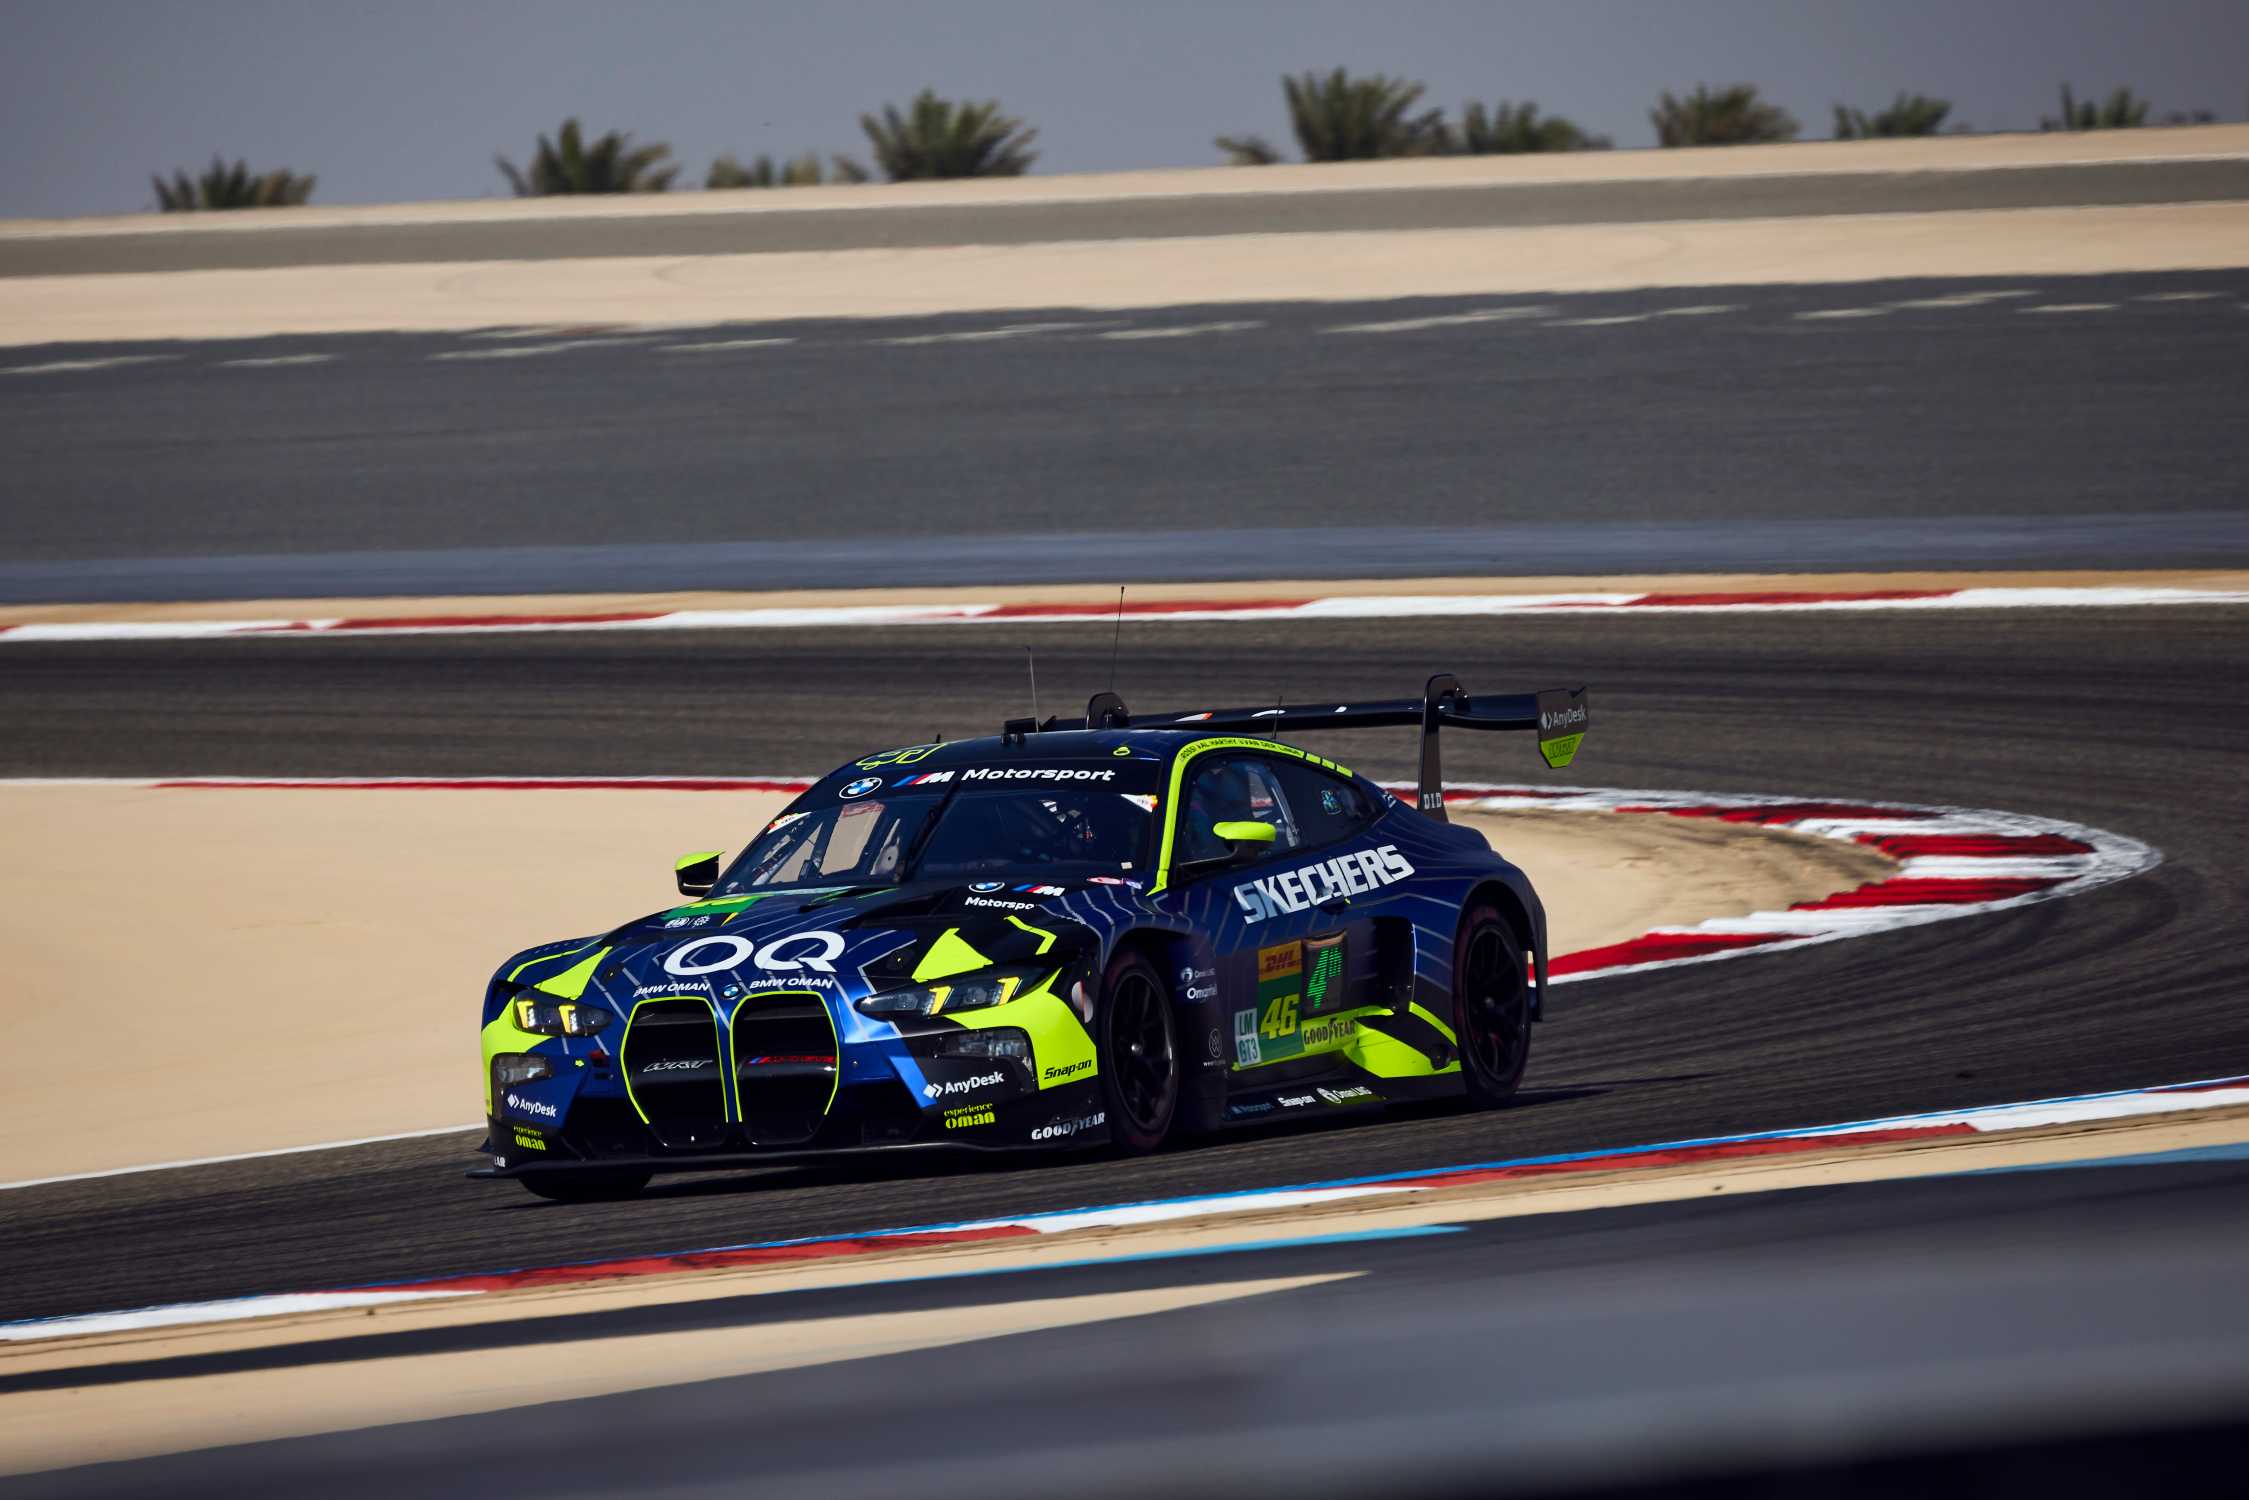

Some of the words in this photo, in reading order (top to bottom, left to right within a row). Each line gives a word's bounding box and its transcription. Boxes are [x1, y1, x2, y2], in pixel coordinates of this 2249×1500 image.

[1553, 704, 1586, 728] AnyDesk
[961, 768, 1116, 781] Motorsport
[1423, 792, 1443, 809] DID
[1233, 844, 1416, 925] SKECHERS
[965, 896, 1035, 911] Motorspo
[663, 930, 846, 976] OQ
[632, 984, 667, 998] BMW
[667, 982, 711, 993] OMAN
[749, 979, 787, 990] BMW
[787, 977, 833, 990] OMAN
[1239, 1011, 1253, 1035] LM
[1259, 993, 1300, 1040] 46
[1303, 1018, 1357, 1046] GOODYEAR
[1239, 1040, 1258, 1063] GT3
[1044, 1058, 1093, 1080] Snap-on
[945, 1071, 1005, 1095] AnyDesk
[520, 1098, 557, 1118] AnyDesk
[944, 1102, 993, 1117] experience
[945, 1111, 996, 1129] oman
[1031, 1112, 1106, 1140] GOODYEAR
[515, 1135, 546, 1151] oman
